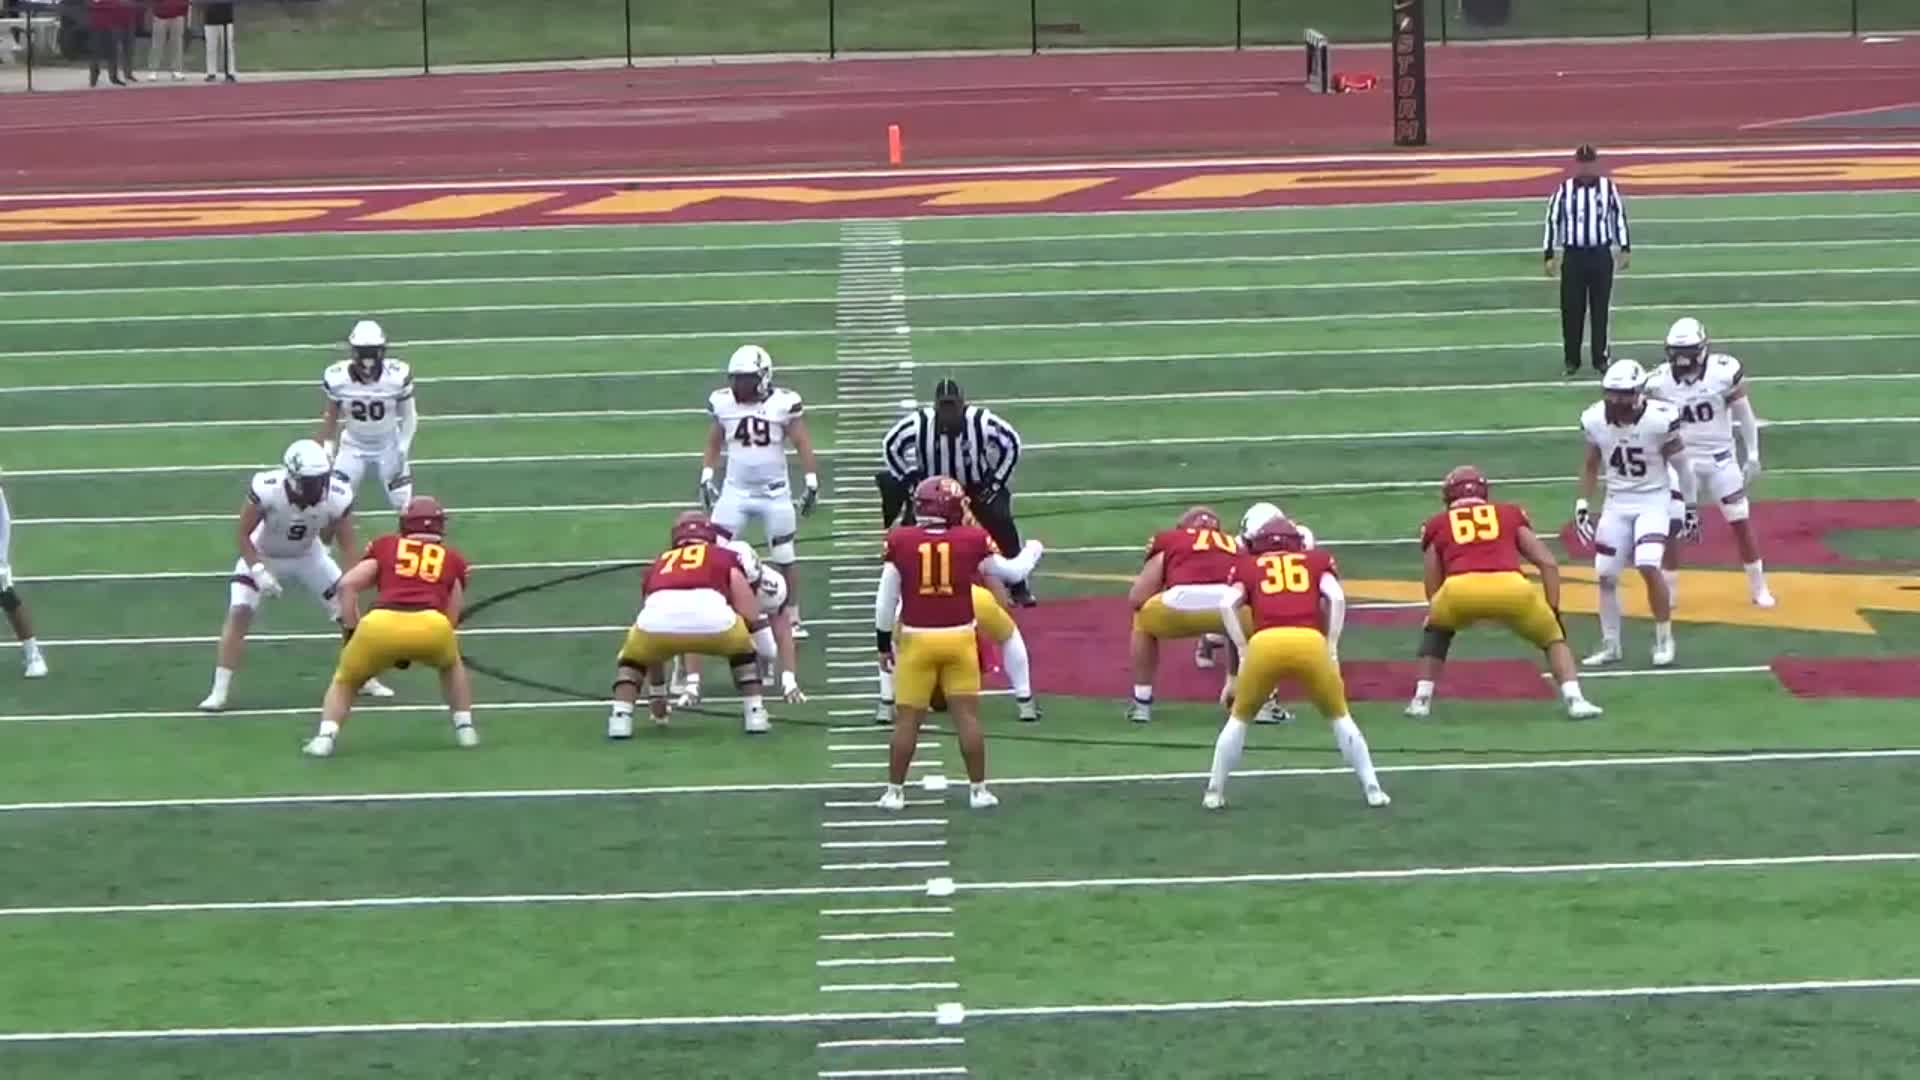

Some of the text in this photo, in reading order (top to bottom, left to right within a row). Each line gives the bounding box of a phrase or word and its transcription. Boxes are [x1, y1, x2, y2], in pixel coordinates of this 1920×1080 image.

[351, 401, 386, 421] 20
[1682, 401, 1714, 423] 40
[734, 416, 771, 447] 49
[1609, 446, 1647, 477] 45
[288, 524, 307, 541] 9
[1449, 504, 1500, 544] 69
[394, 538, 446, 582] 58
[659, 543, 708, 575] 79
[918, 542, 953, 595] 11
[1256, 553, 1310, 594] 36
